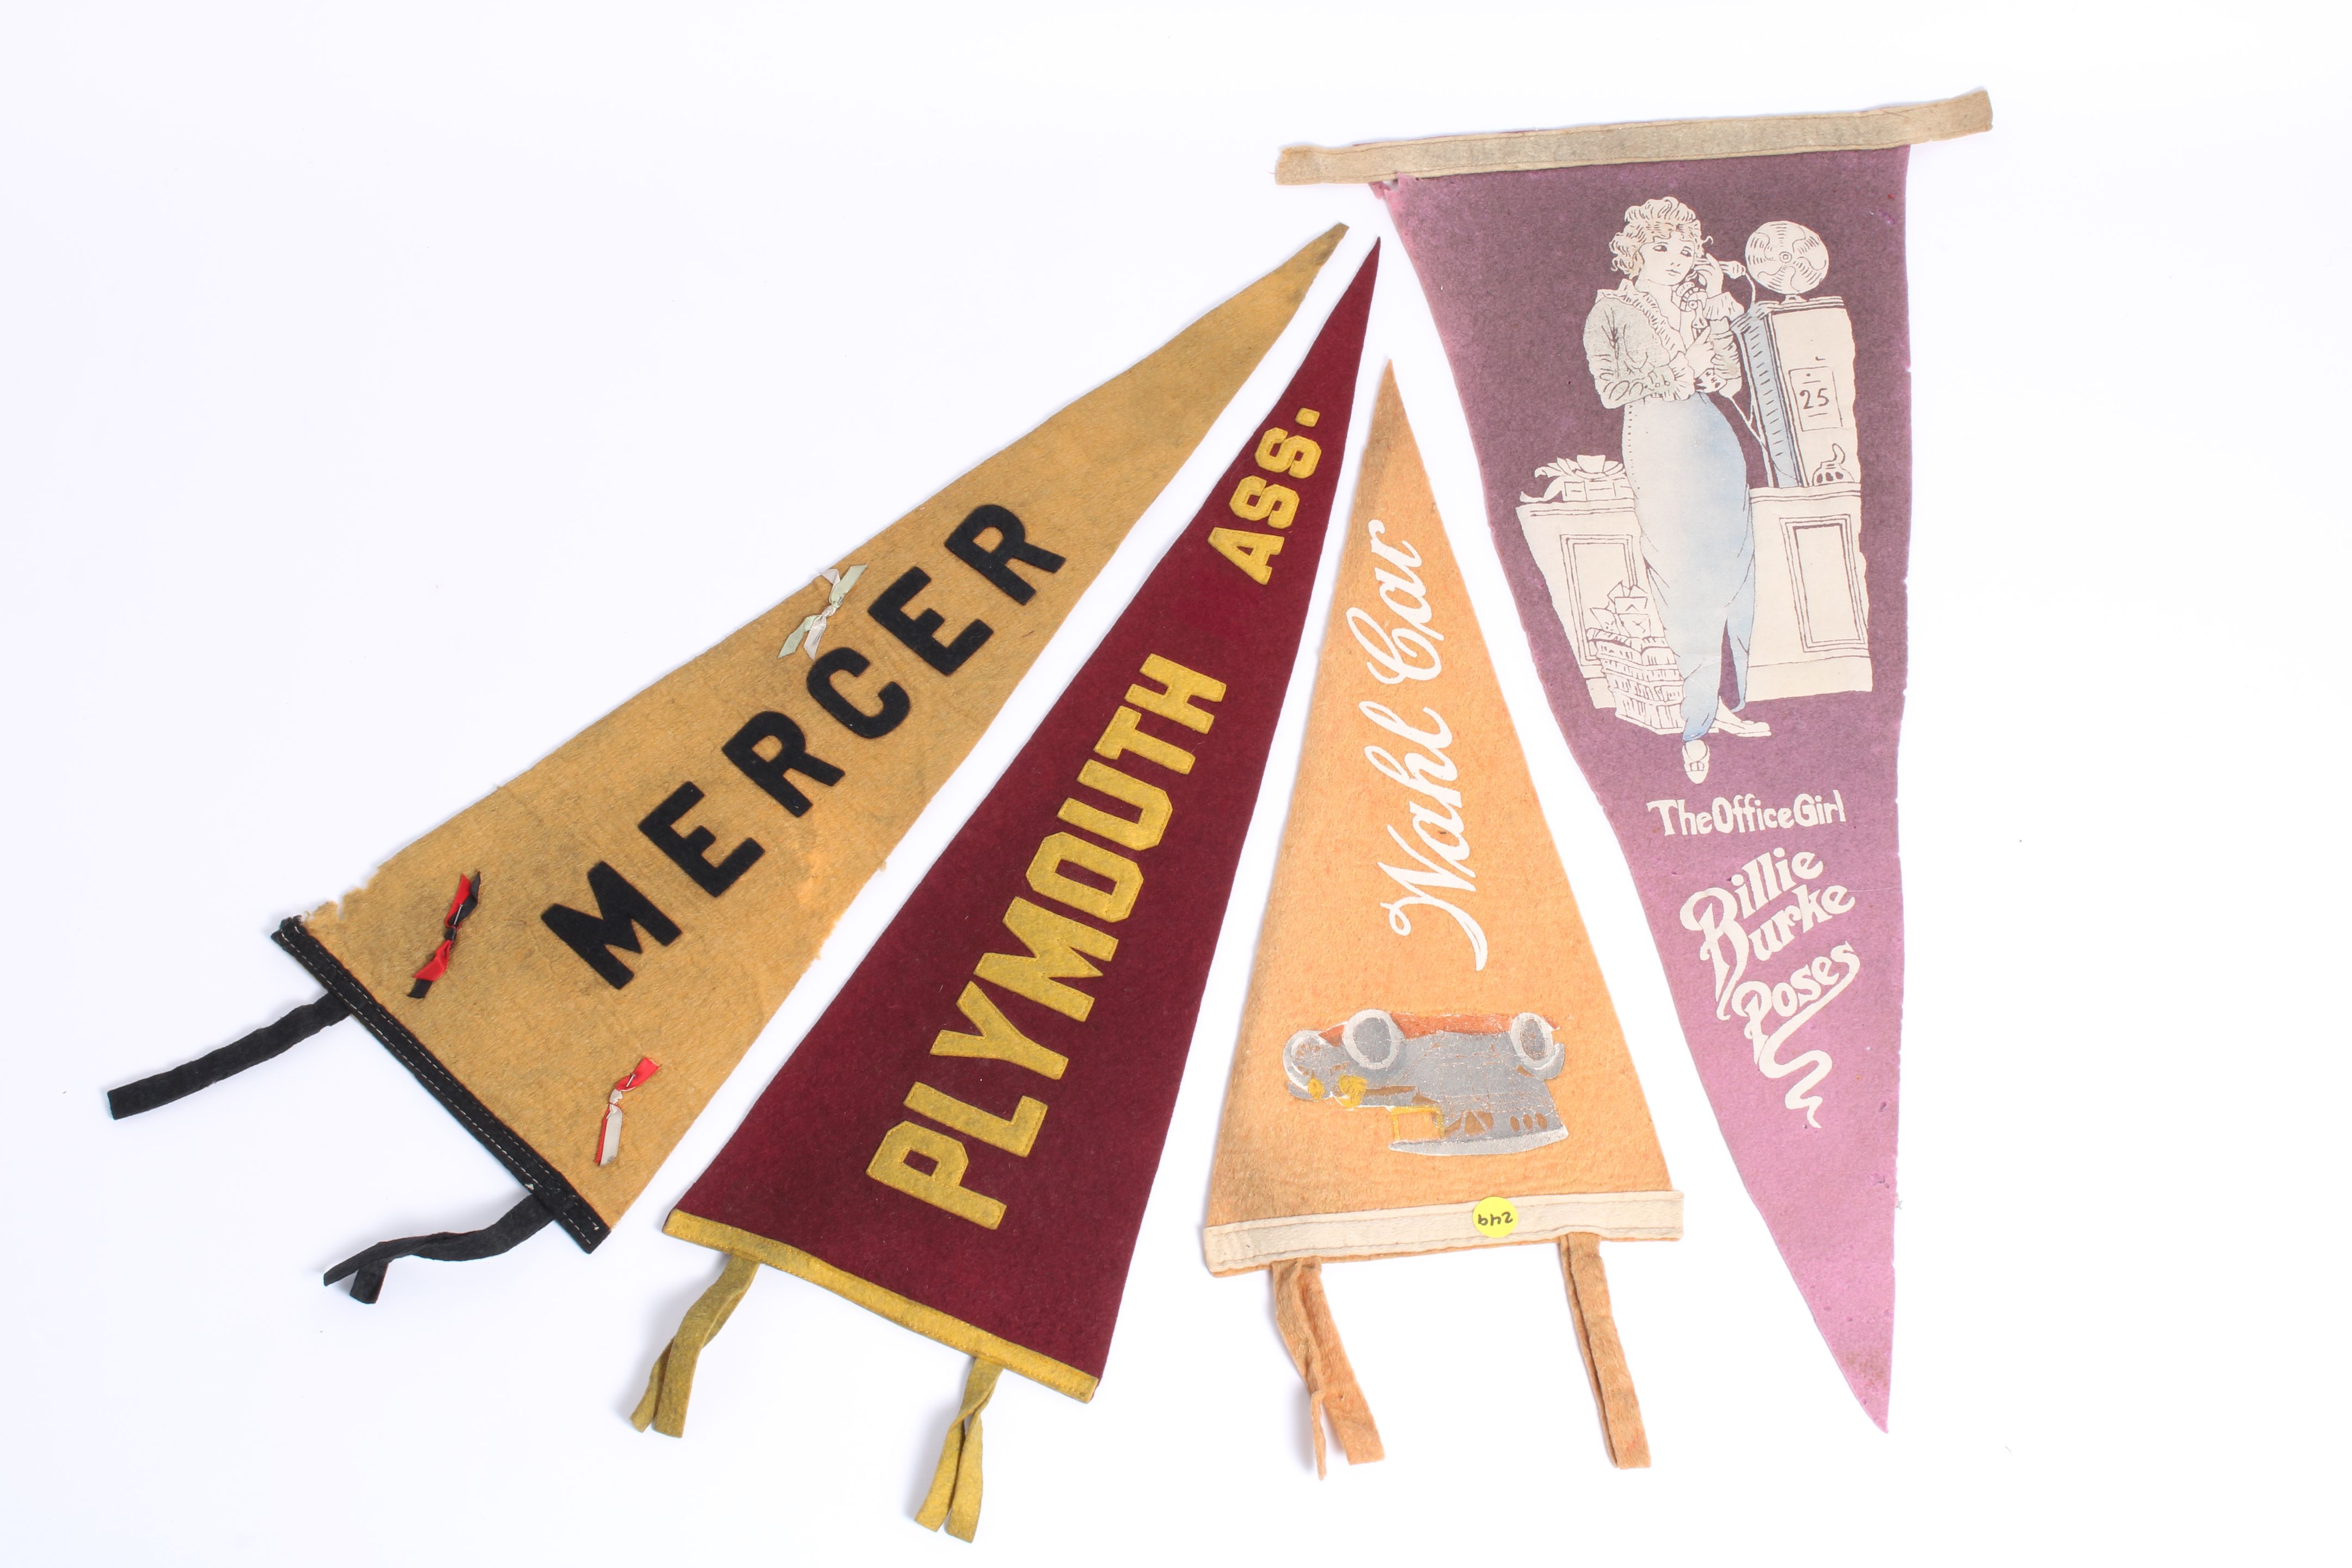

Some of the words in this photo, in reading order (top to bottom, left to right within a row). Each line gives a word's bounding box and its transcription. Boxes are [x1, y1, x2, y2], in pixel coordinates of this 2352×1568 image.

[1799, 387, 1830, 410] 25
[1346, 519, 1444, 684] Car
[541, 504, 1066, 990] MERCER
[1358, 701, 1488, 971] Wahl
[865, 653, 1226, 1229] PLYMOUTH
[1679, 884, 1855, 1021] Burke
[1731, 940, 1860, 1129] Poses
[1478, 1211, 1514, 1227] 249
